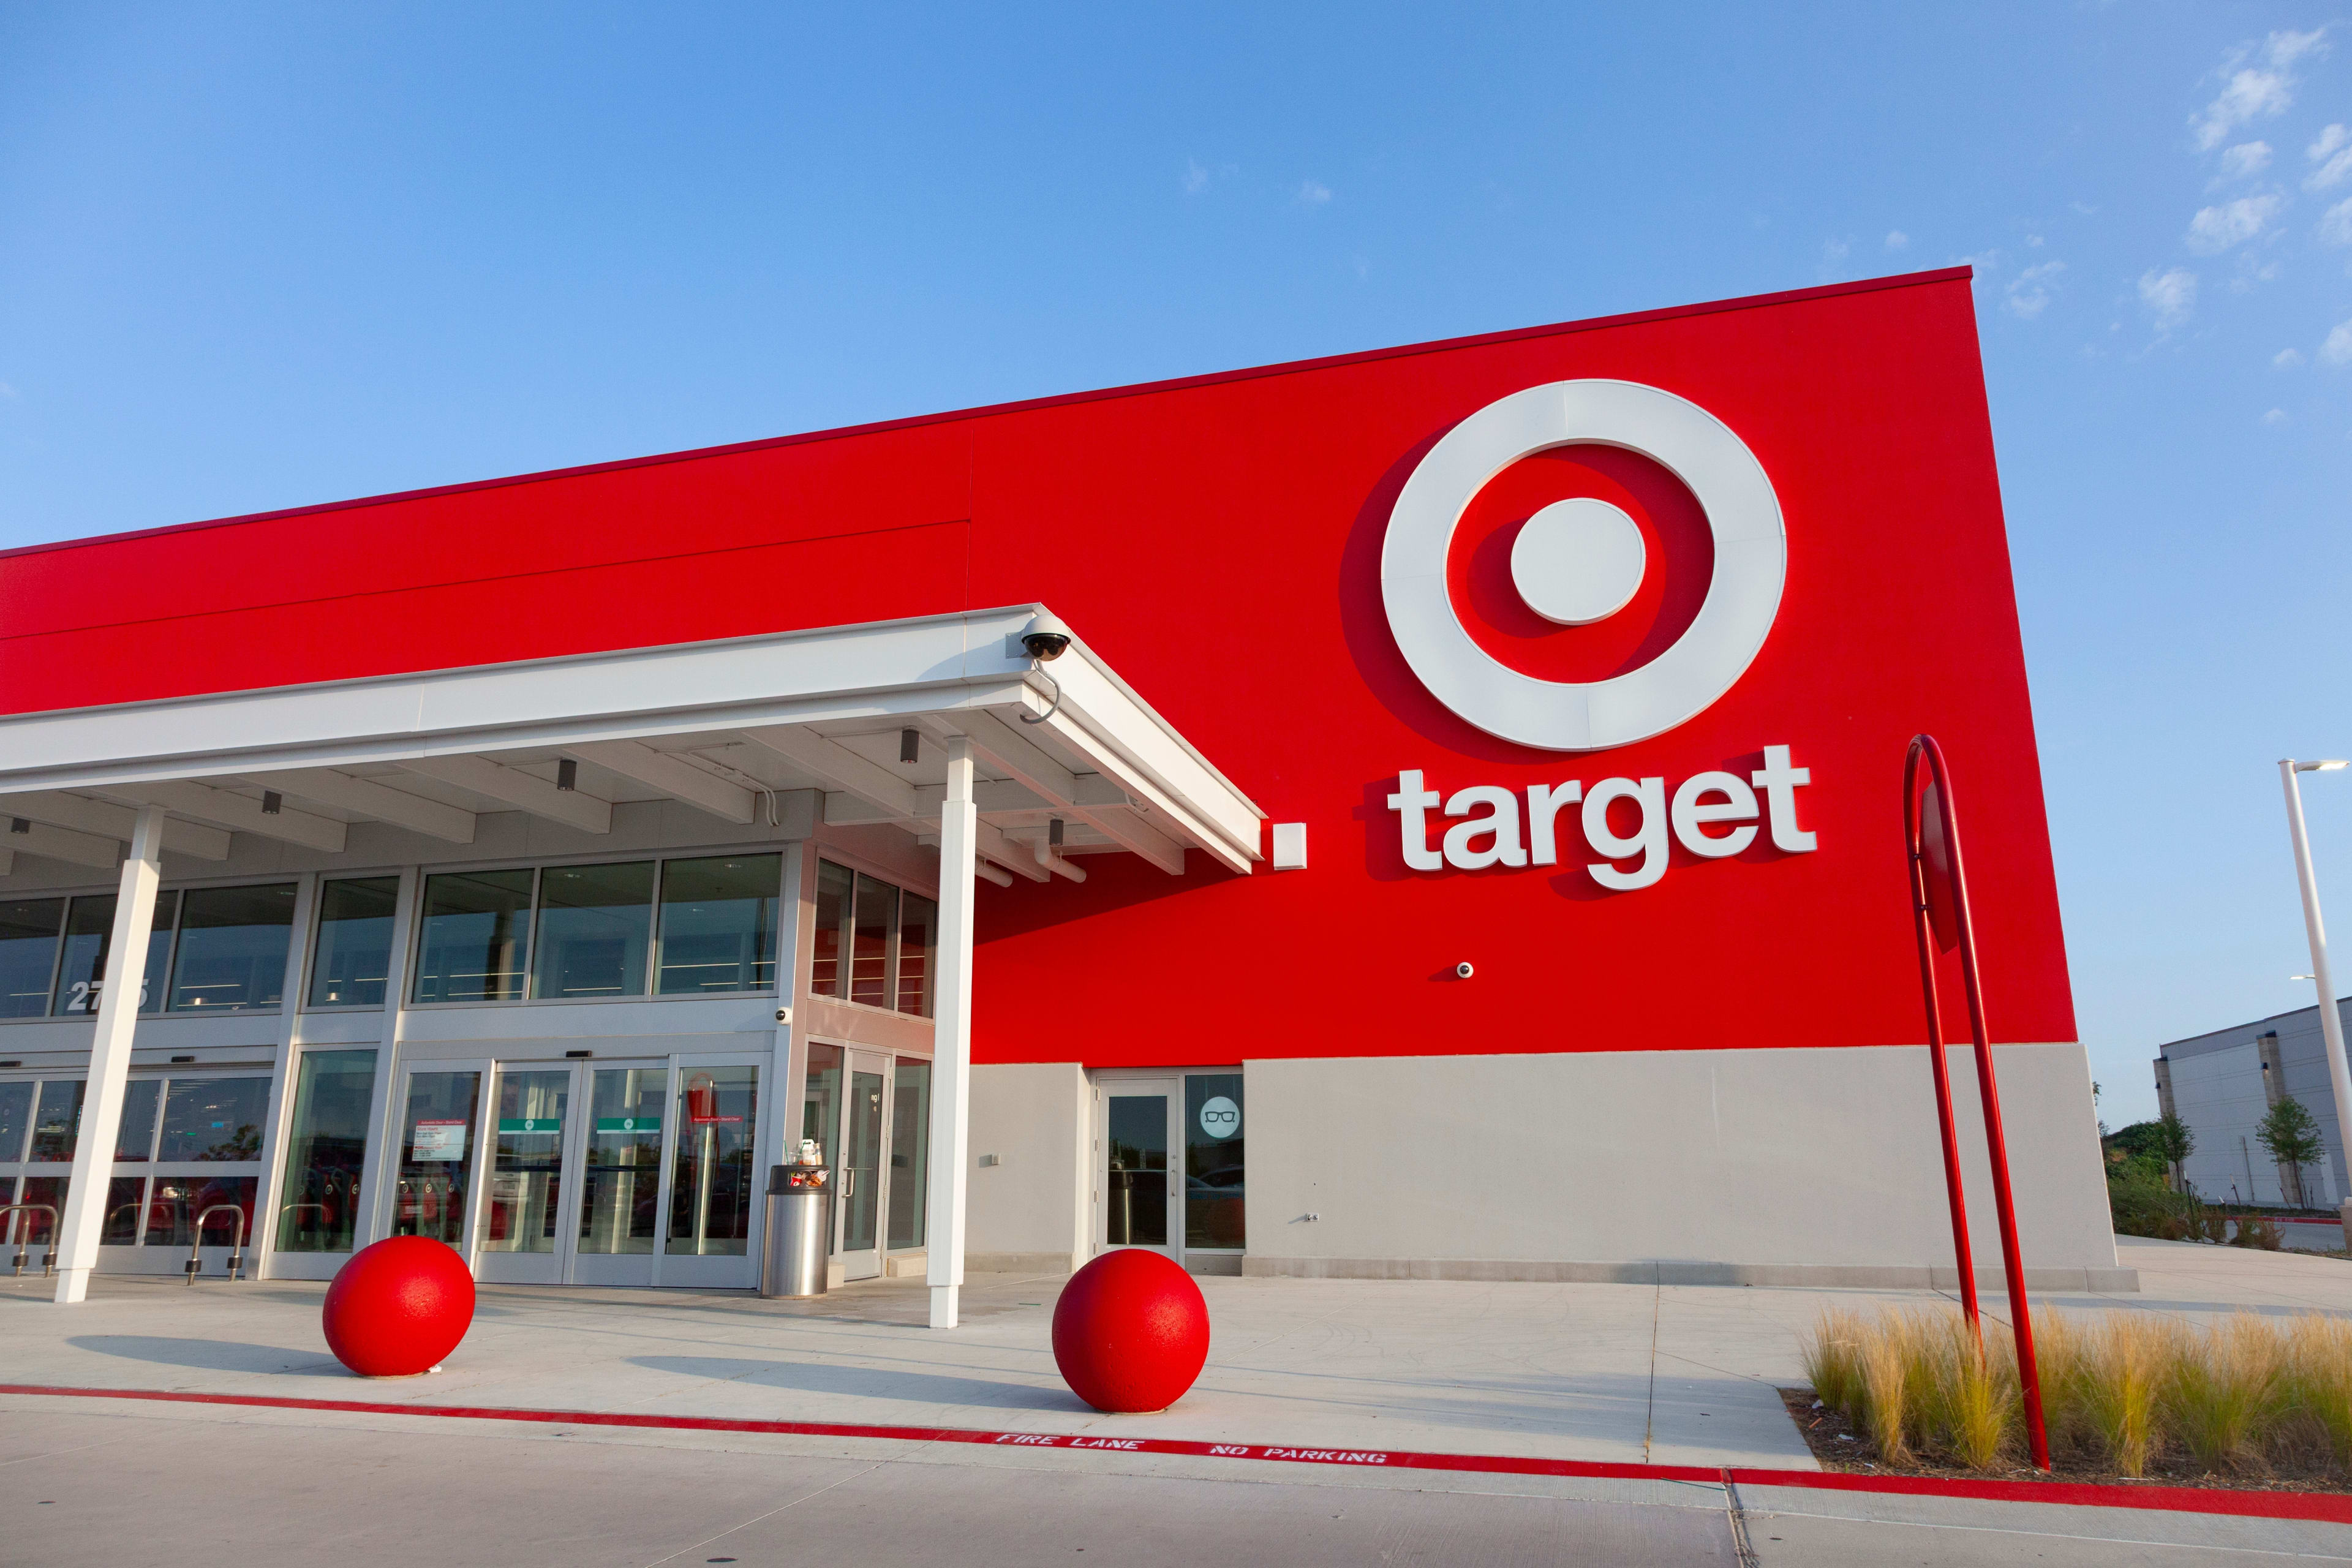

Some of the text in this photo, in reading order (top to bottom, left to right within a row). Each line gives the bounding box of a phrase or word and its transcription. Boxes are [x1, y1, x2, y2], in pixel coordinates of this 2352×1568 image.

[1387, 744, 1817, 892] target
[67, 979, 149, 1011] 27
[996, 1434, 1387, 1463] FIRE LANE NO PARKING
